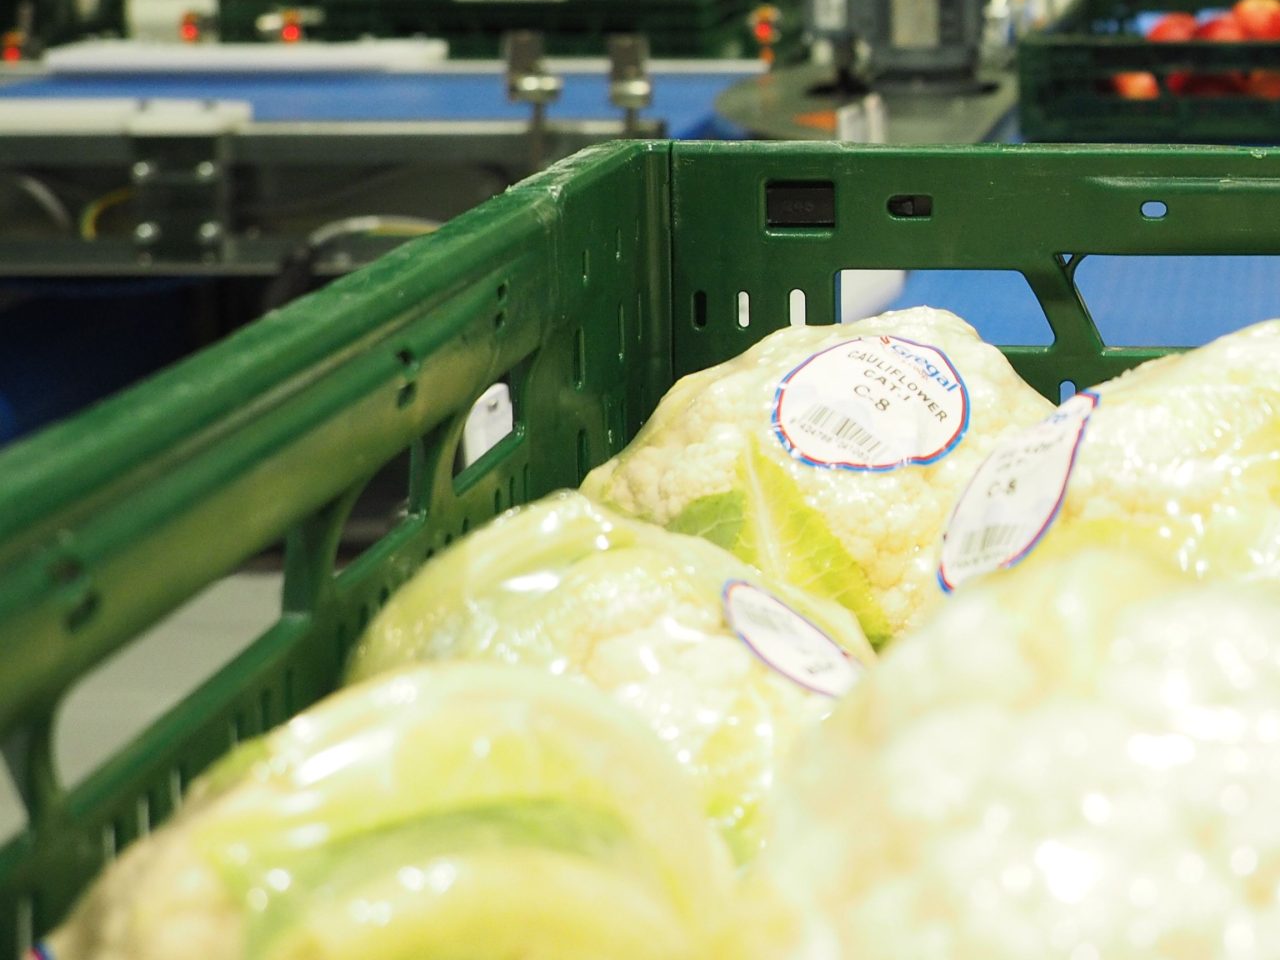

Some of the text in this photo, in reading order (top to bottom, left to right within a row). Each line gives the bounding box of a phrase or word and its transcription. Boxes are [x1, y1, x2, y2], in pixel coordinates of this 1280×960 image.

[847, 349, 948, 422] CAULIFLOWER
[890, 343, 959, 392] Gregal
[853, 383, 891, 412] C-8
